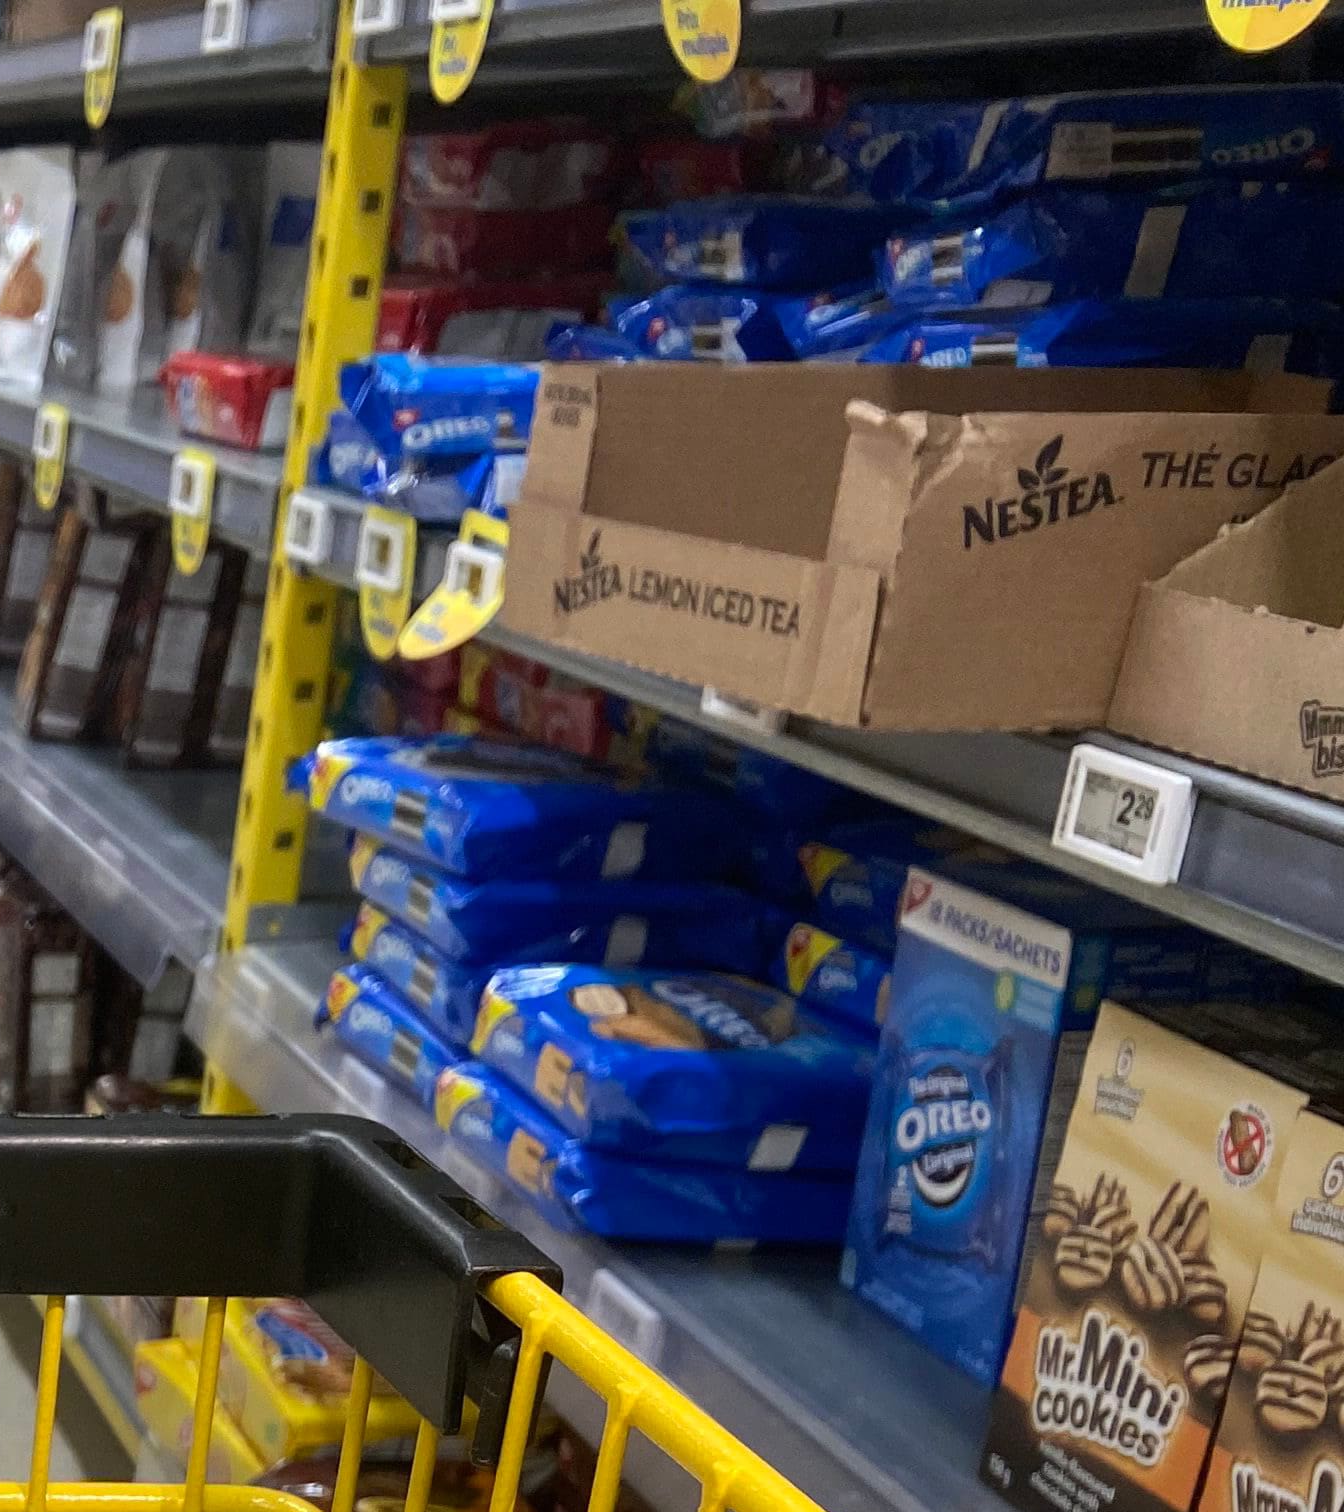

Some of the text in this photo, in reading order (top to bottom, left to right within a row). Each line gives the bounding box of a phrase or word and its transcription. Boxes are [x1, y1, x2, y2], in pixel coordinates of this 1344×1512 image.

[1142, 444, 1217, 489] THÉ
[629, 566, 701, 616] LEMON
[761, 596, 800, 638] TEA
[896, 1100, 992, 1152] OREO
[1040, 1315, 1180, 1427] Mr. Mini
[1036, 1386, 1160, 1460] cookies
